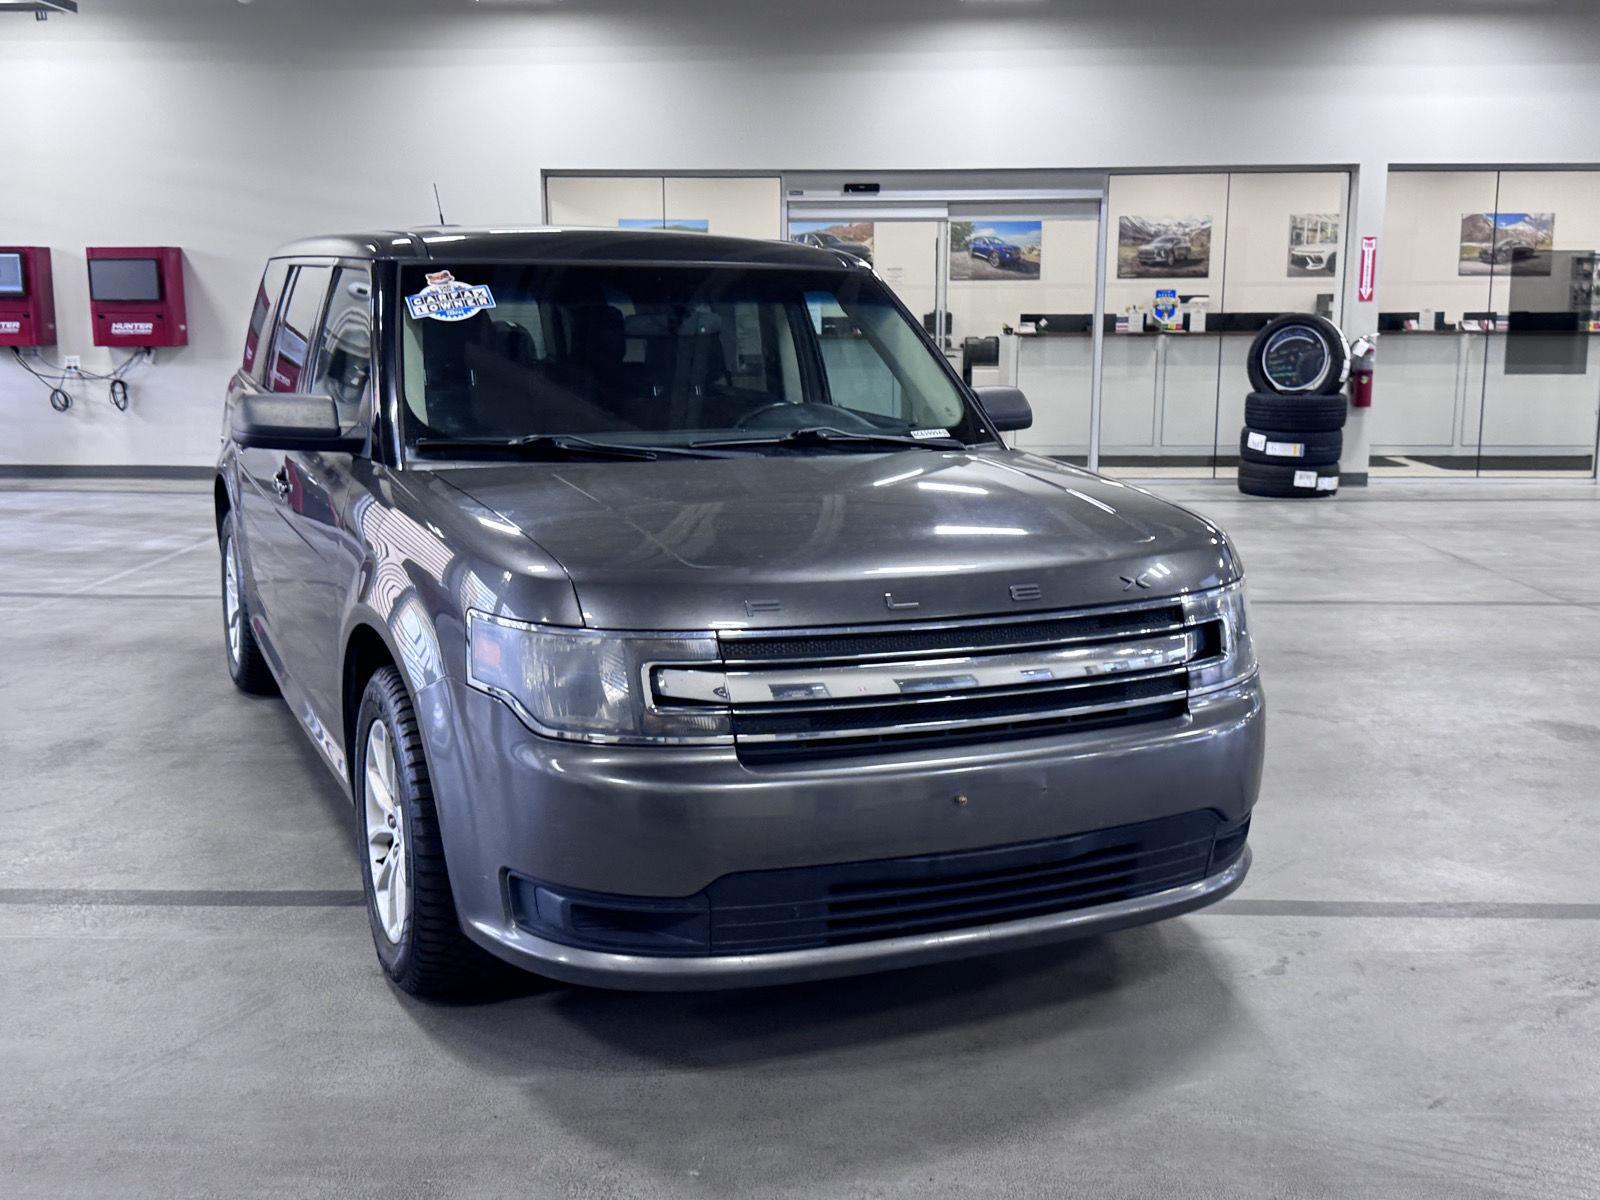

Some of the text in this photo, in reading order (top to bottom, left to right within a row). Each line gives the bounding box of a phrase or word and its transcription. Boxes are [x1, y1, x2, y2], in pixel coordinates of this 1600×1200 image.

[413, 288, 487, 305] CARFAX
[428, 297, 489, 312] OWNER
[111, 322, 153, 330] HUNTER
